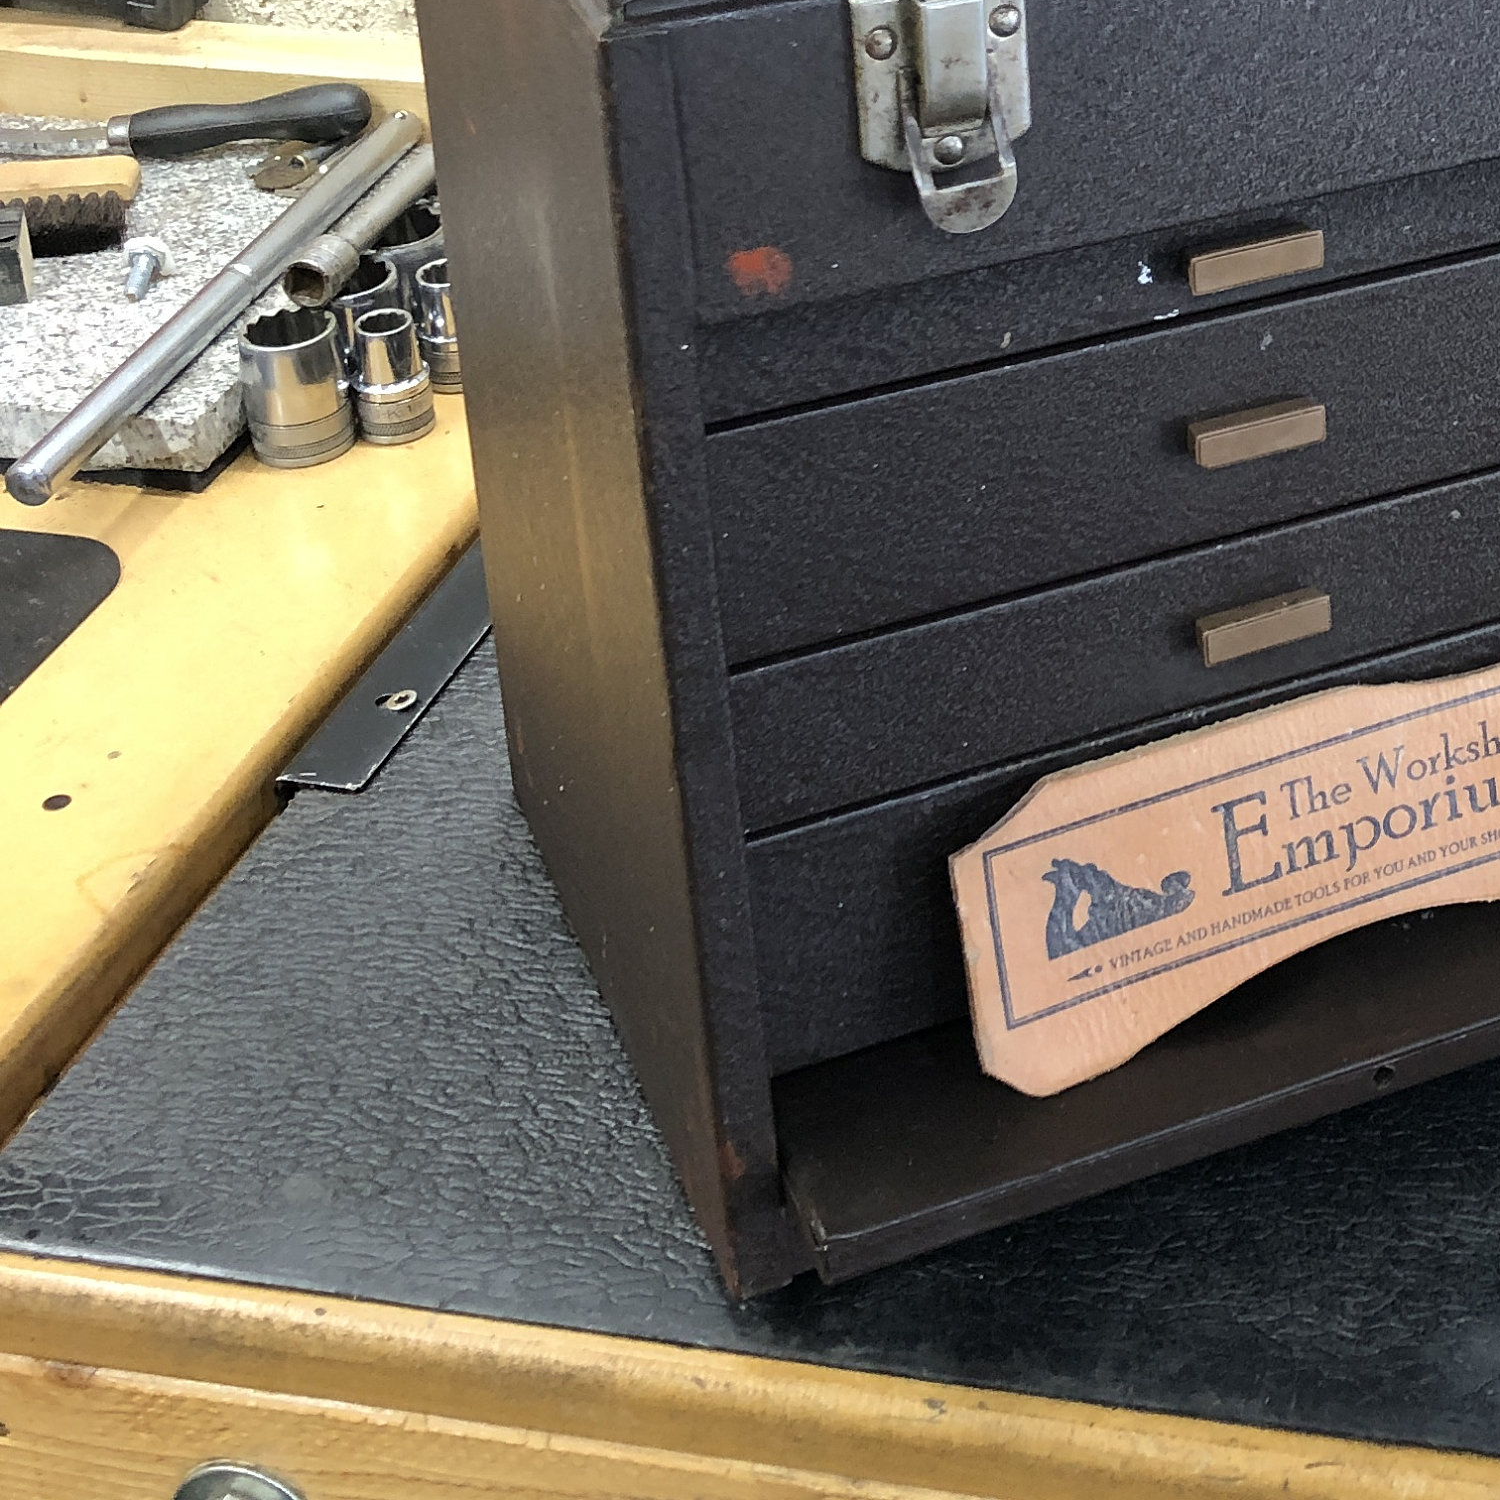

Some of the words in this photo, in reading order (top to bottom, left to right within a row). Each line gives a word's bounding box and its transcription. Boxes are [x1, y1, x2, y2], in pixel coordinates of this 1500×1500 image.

[1280, 776, 1352, 821] The
[1109, 938, 1173, 970] VINTAGE
[1176, 926, 1208, 949] AND
[1210, 897, 1293, 935] HANDMADE
[1296, 880, 1342, 908] TOOLS
[1343, 869, 1373, 891] FOR
[1373, 859, 1406, 879] YOU
[1407, 850, 1437, 869] AND
[1439, 835, 1478, 859] YOUR
